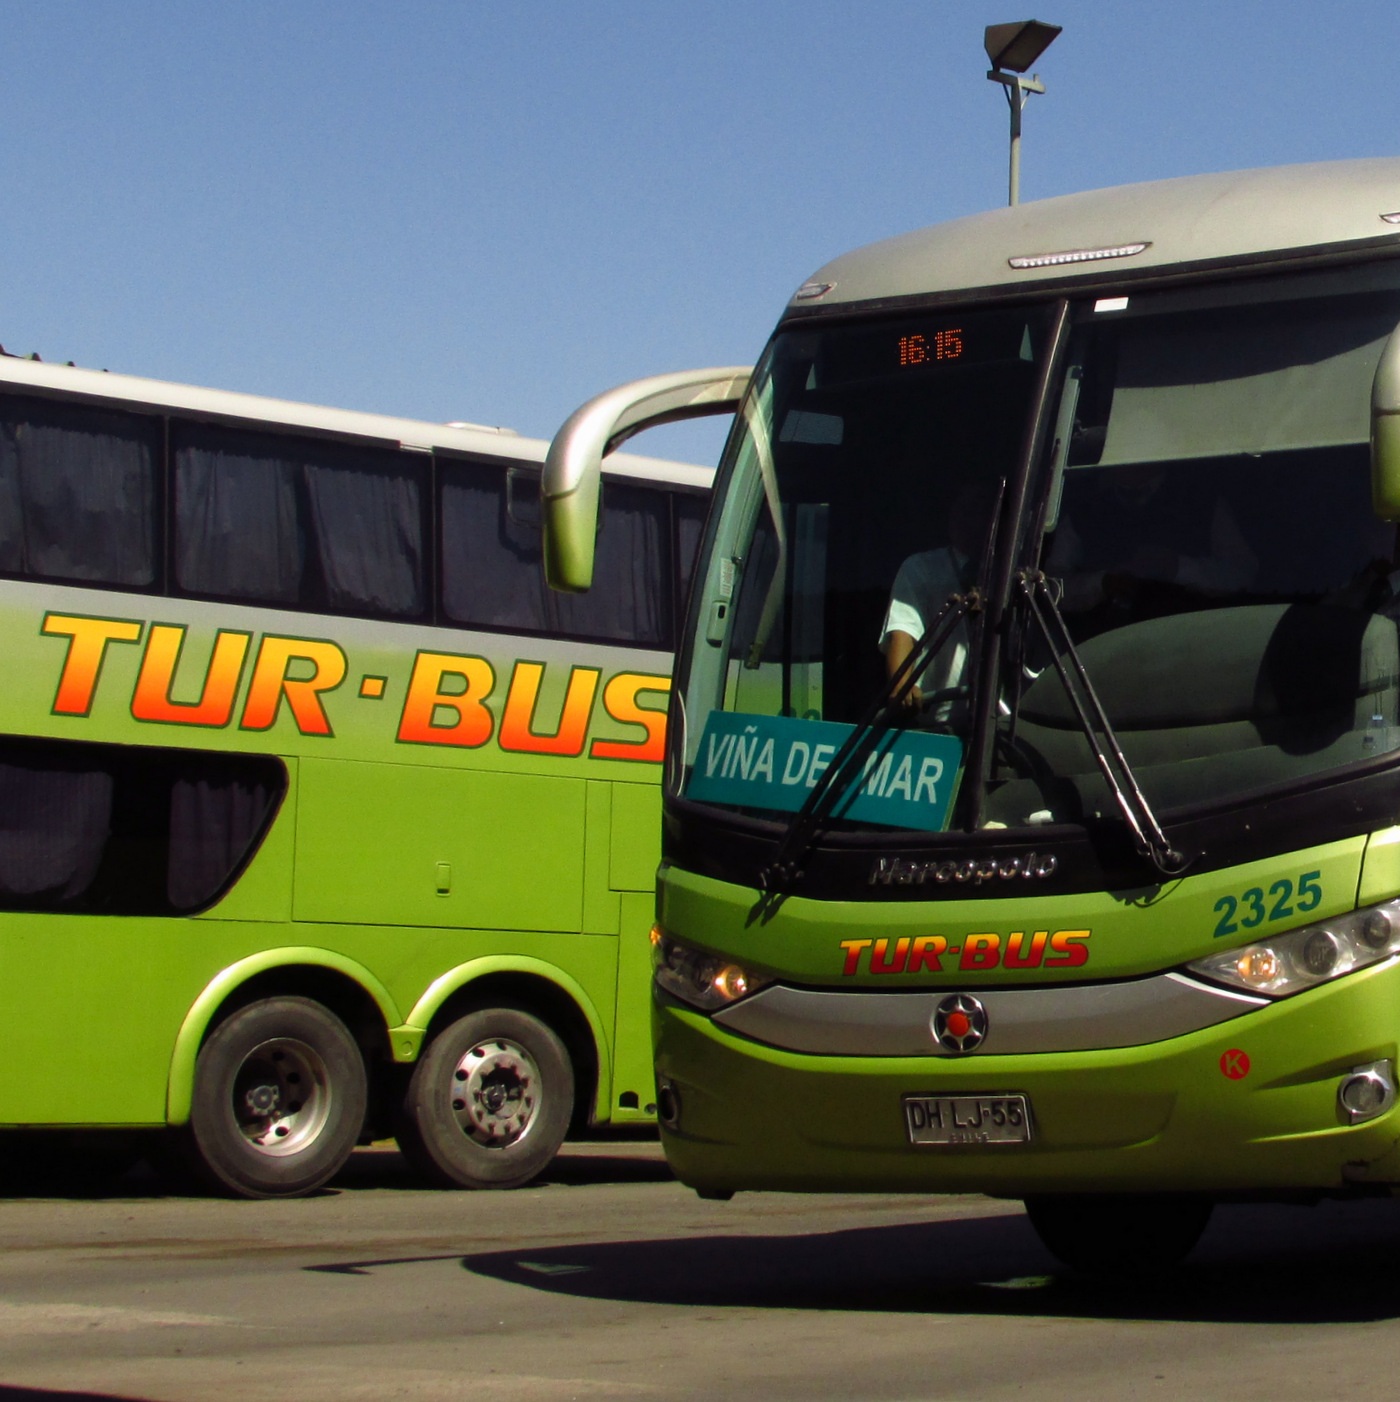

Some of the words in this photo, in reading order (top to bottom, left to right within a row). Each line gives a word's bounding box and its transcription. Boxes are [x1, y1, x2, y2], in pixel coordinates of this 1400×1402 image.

[899, 329, 963, 365] 16:15
[704, 725, 775, 783] VIÑA
[859, 750, 944, 804] MAR
[869, 851, 1058, 886] Marcopolo
[1213, 869, 1323, 939] 2325
[1225, 1052, 1245, 1075] K
[909, 1101, 944, 1129] DH
